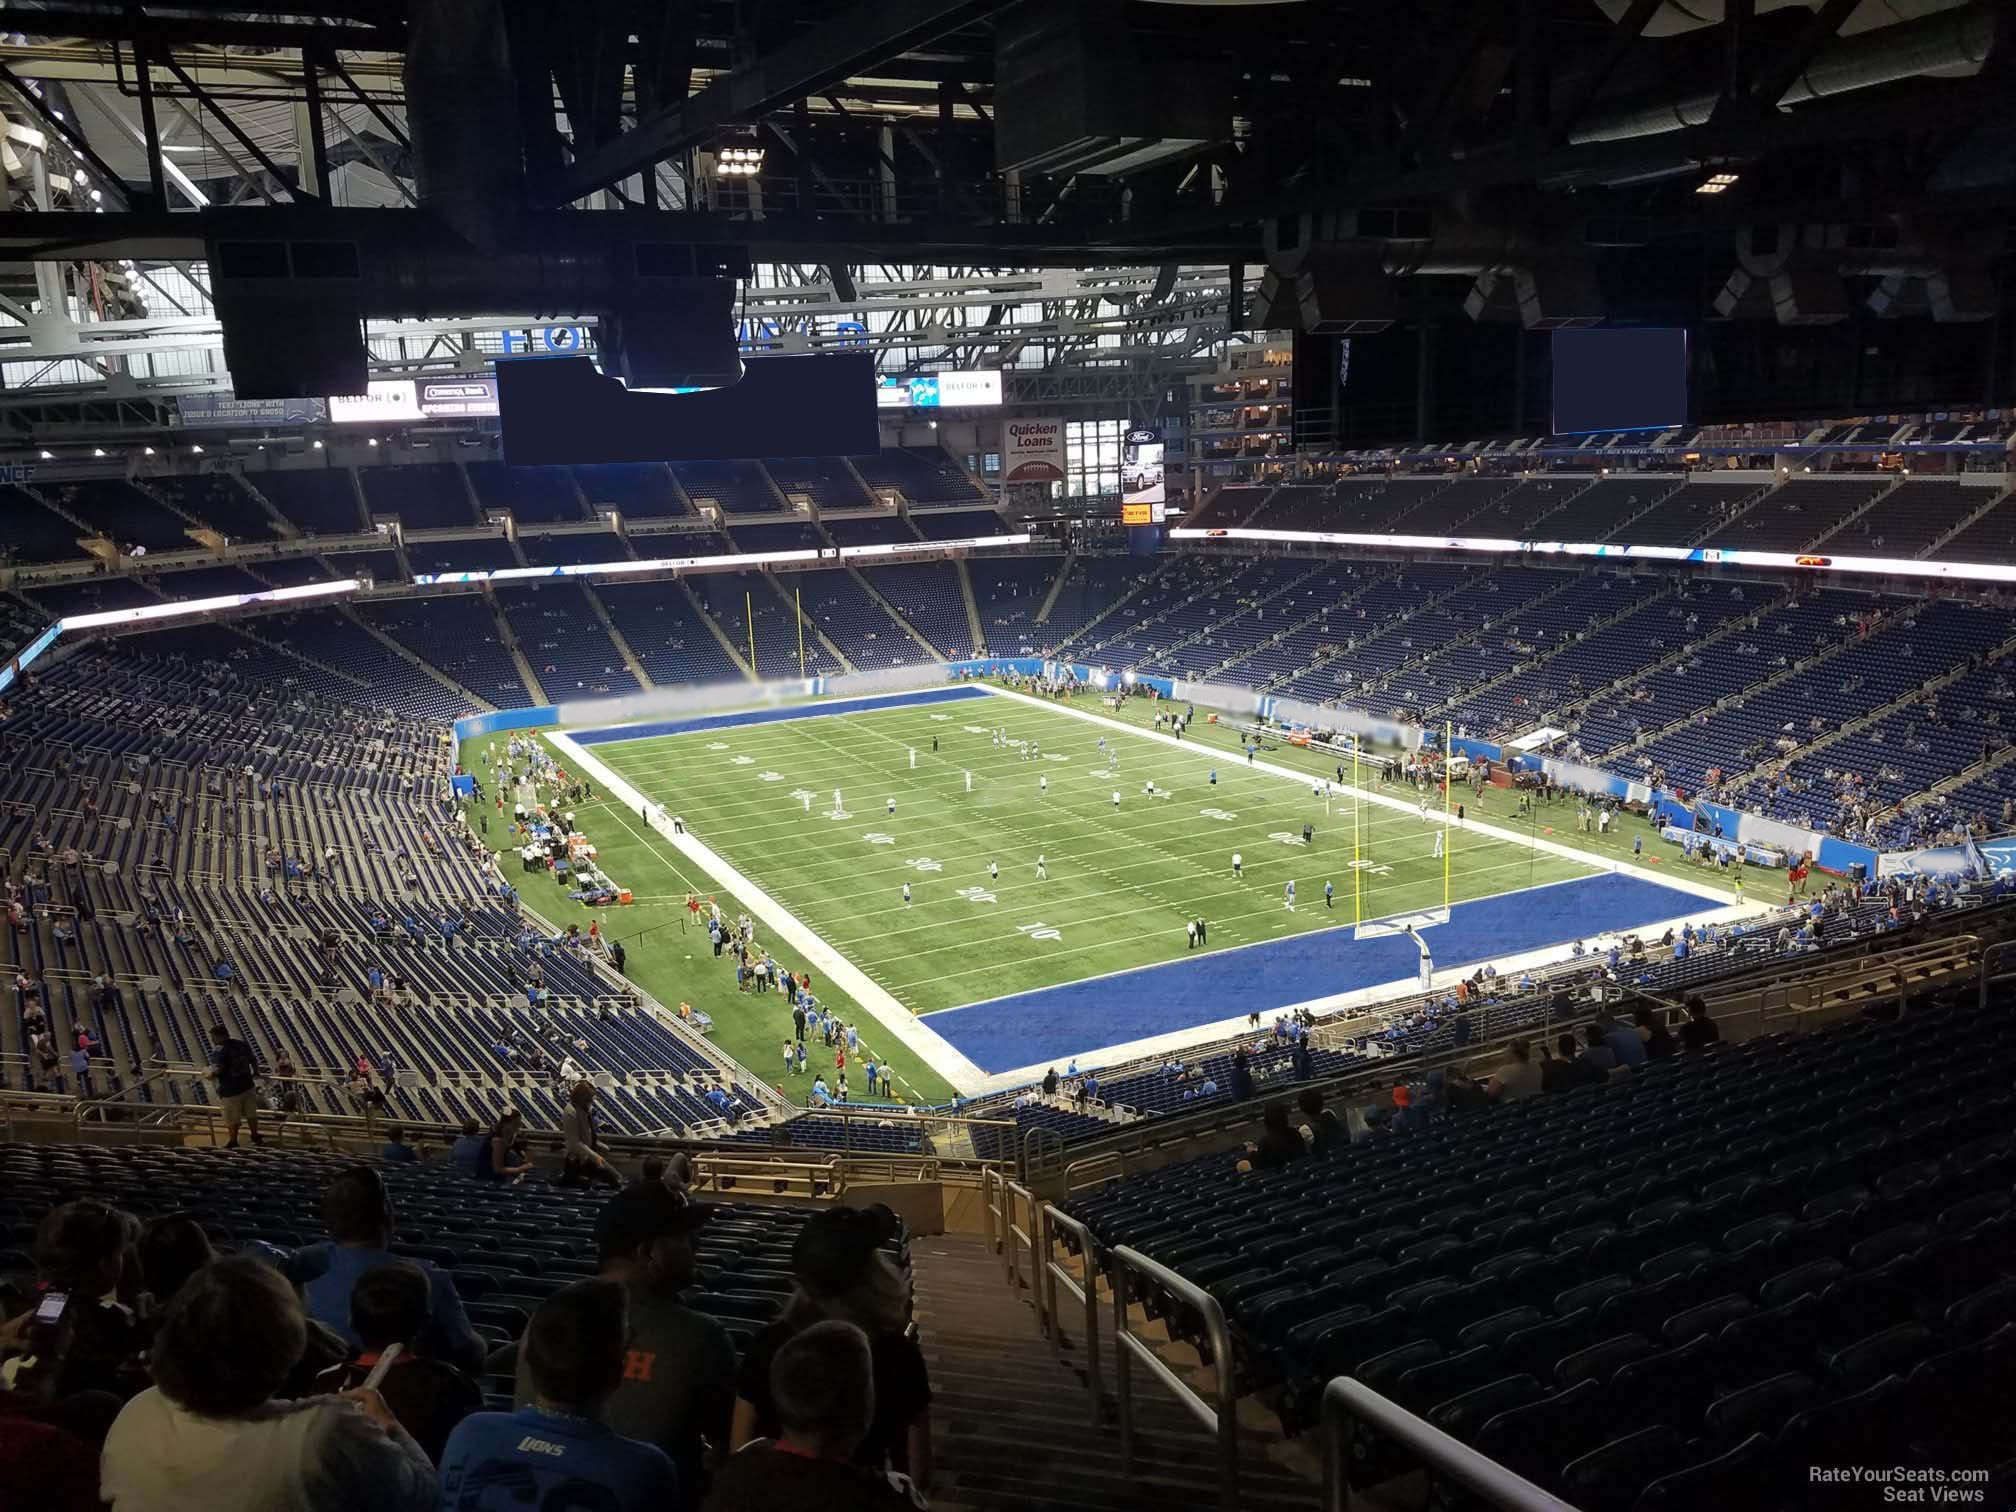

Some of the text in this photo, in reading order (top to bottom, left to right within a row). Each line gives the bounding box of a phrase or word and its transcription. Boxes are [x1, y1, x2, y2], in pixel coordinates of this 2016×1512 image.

[1009, 423, 1058, 436] Quicken
[1017, 436, 1054, 448] Loans
[1016, 922, 1062, 941] 10
[624, 1351, 656, 1381] H
[517, 1436, 567, 1457] LIONS
